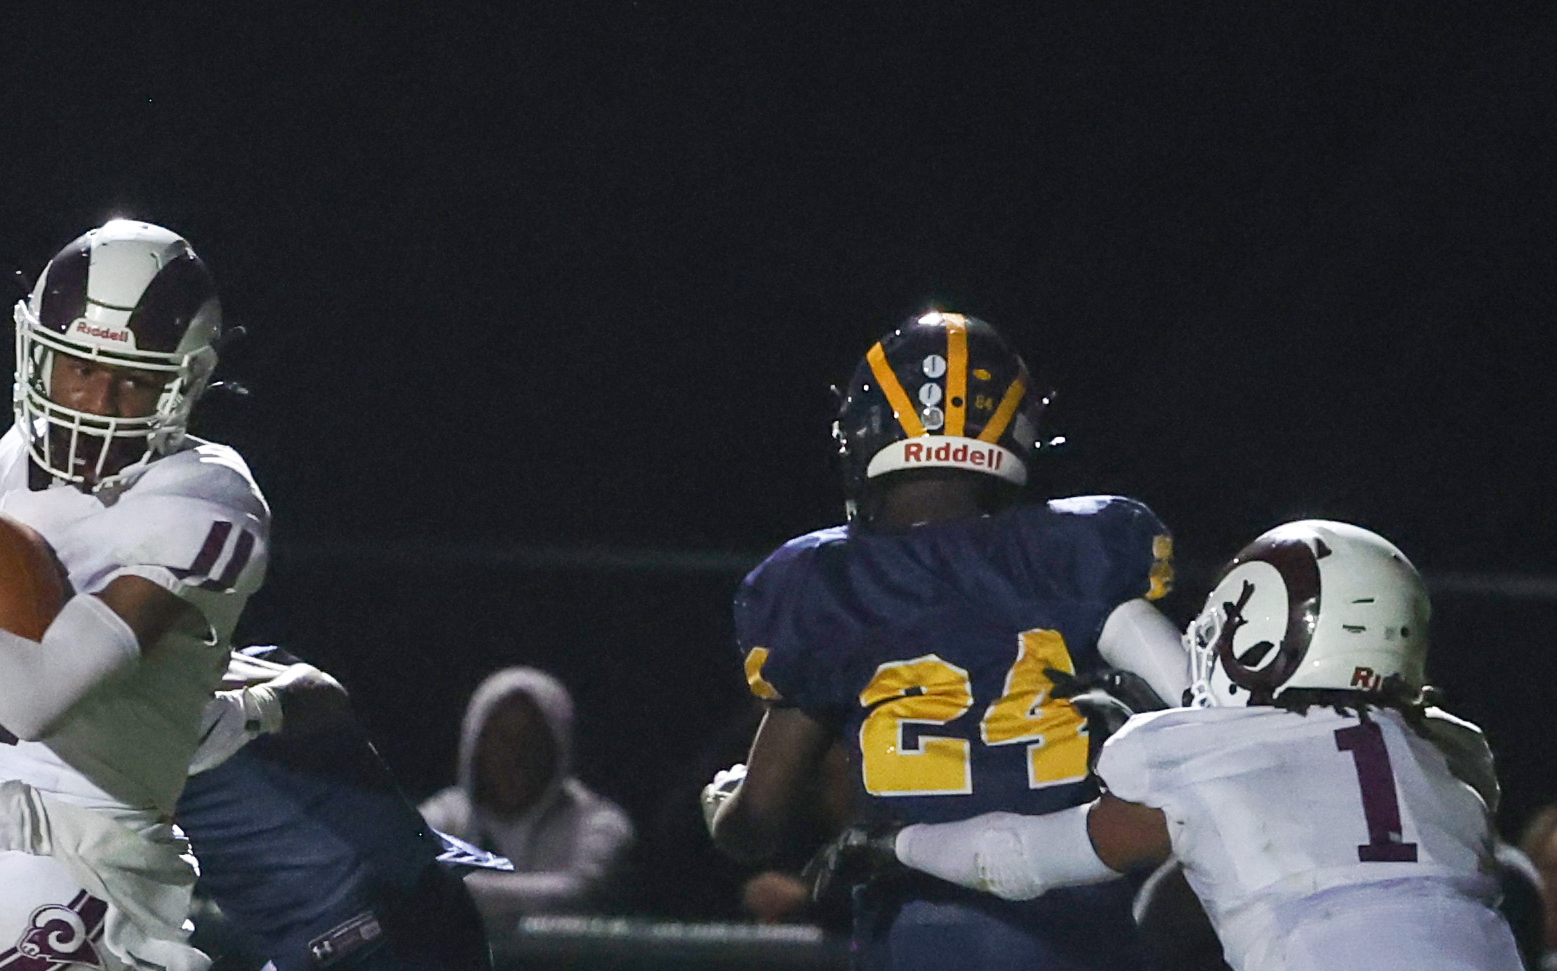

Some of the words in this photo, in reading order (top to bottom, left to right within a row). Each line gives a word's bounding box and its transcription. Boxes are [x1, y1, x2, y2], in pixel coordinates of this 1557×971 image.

[76, 321, 129, 342] Riddell
[904, 442, 1004, 470] Riddell
[859, 628, 1090, 797] 24
[1333, 721, 1419, 863] 1
